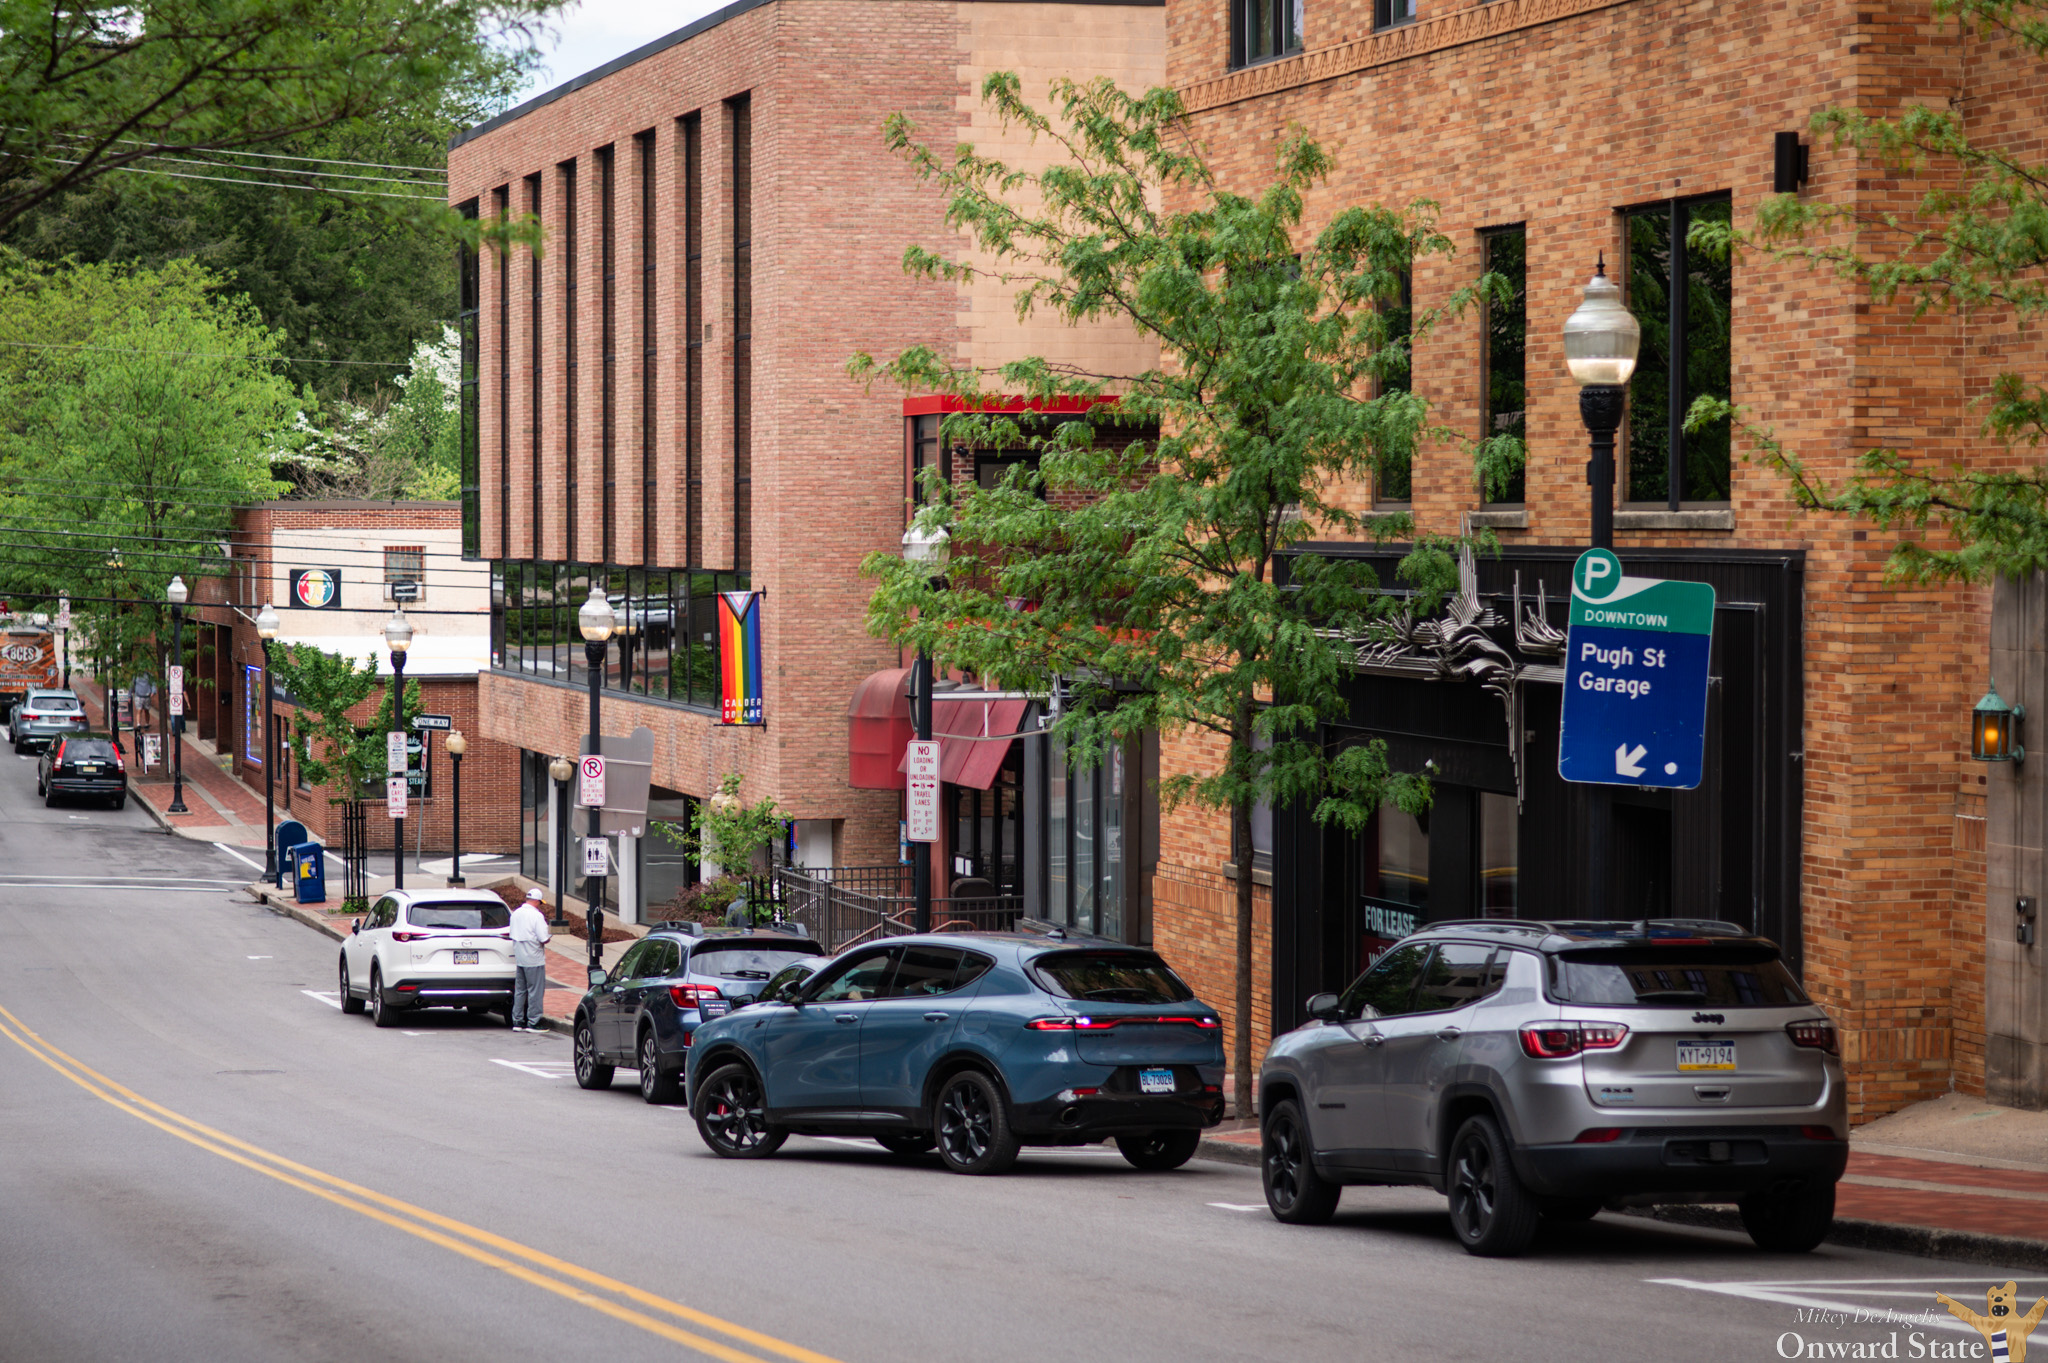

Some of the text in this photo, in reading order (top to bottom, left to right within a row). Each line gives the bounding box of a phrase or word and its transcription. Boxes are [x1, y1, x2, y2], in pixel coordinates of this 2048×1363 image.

[1584, 556, 1612, 591] P
[1585, 609, 1668, 627] DOWNTOWN
[10, 646, 34, 661] BCES
[1581, 643, 1666, 670] Pugh St
[1579, 671, 1651, 700] Garage
[725, 698, 762, 707] CALDER
[725, 709, 761, 718] SQUARE
[918, 746, 930, 755] NO
[1365, 905, 1415, 938] FOR LEASE
[1692, 1011, 1725, 1025] Jeep
